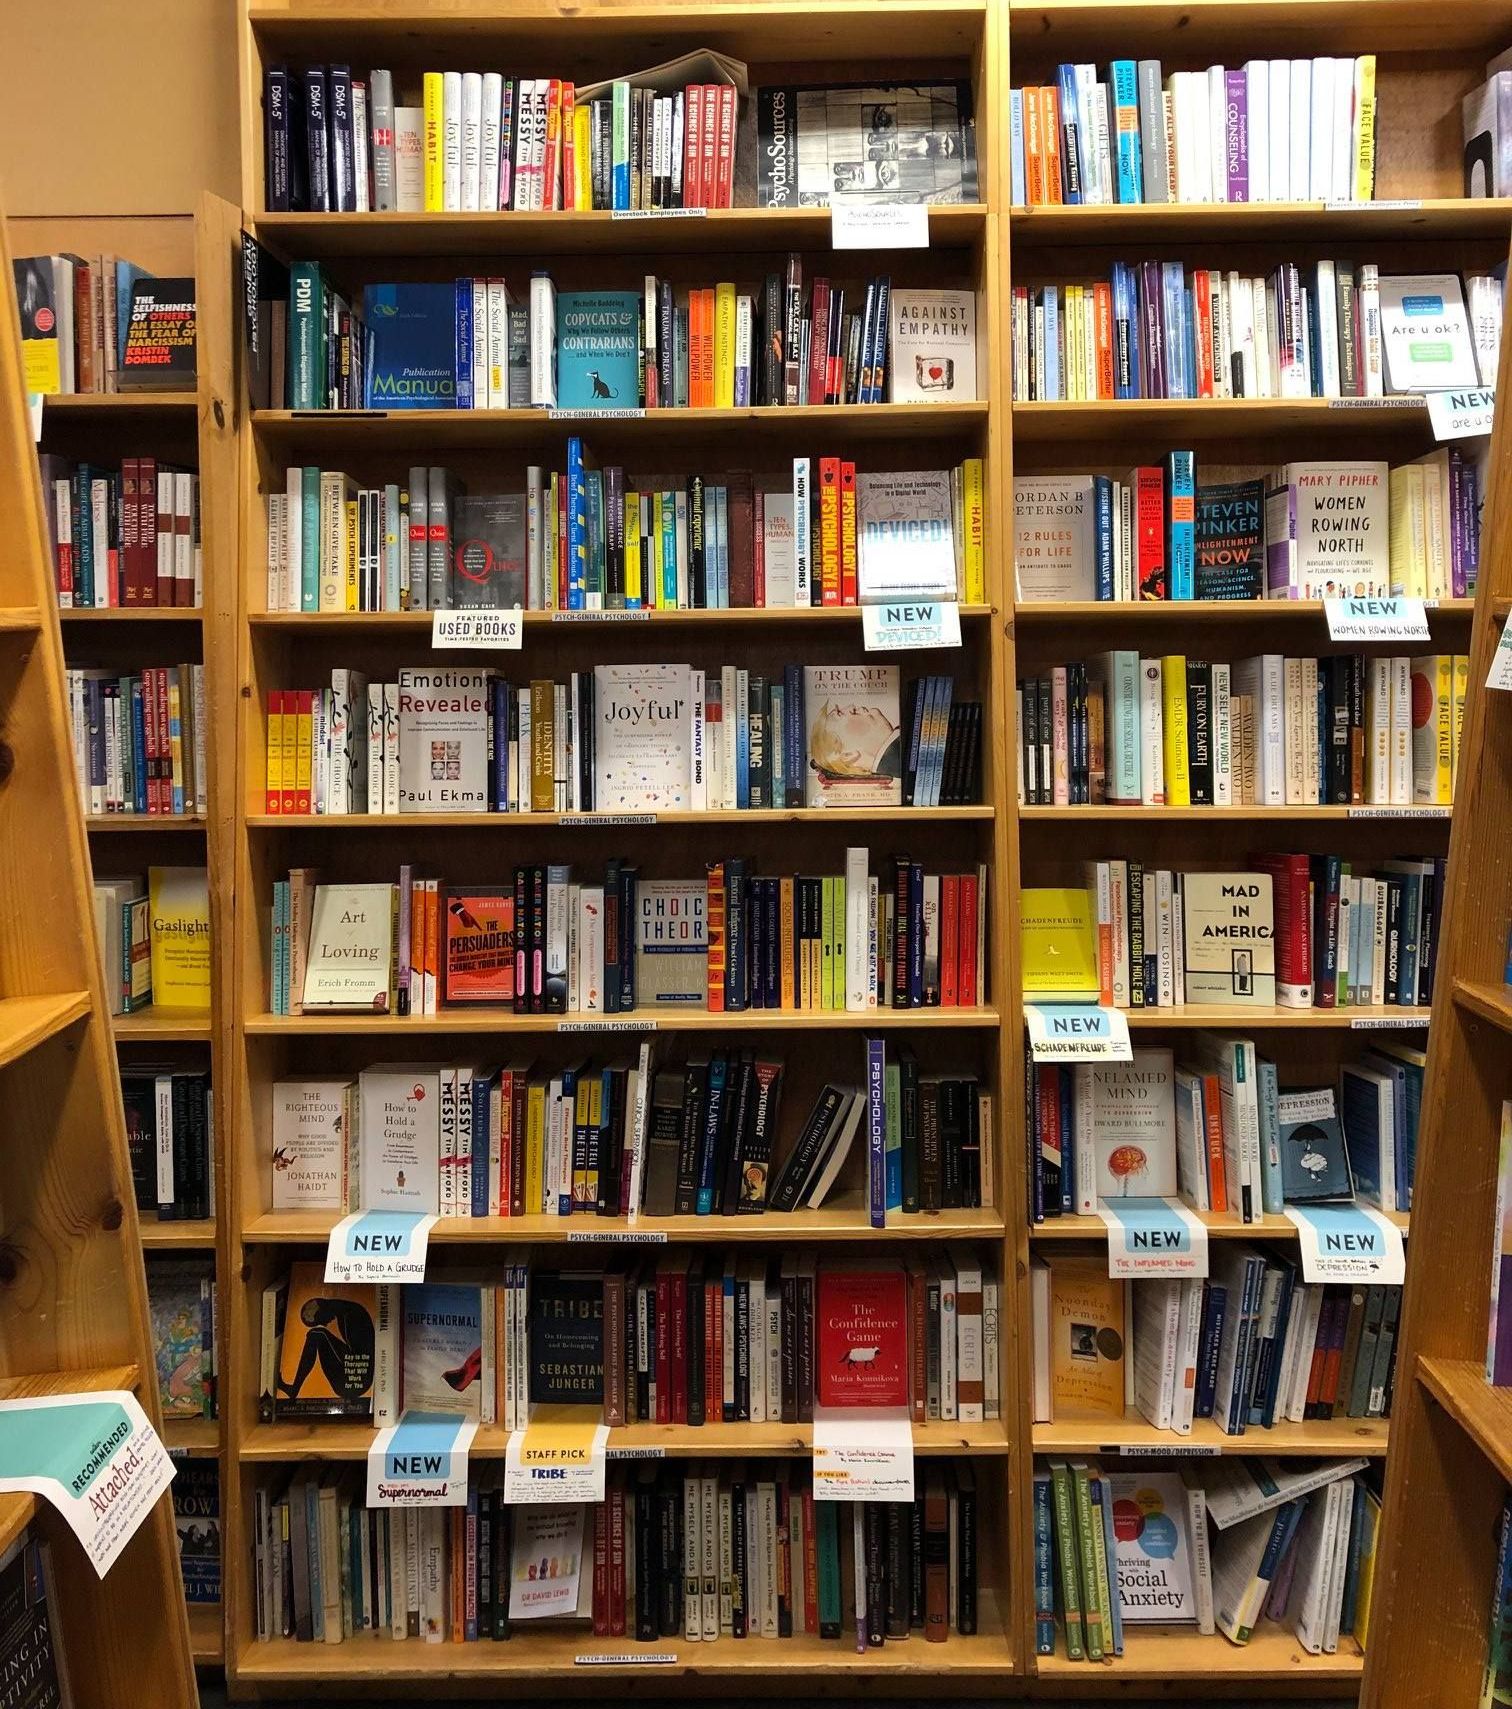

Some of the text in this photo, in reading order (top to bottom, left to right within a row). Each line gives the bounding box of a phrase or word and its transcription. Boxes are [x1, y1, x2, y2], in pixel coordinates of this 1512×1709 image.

[1117, 69, 1125, 100] PINKER
[521, 94, 531, 144] MESSY
[428, 122, 436, 162] HABIT
[1229, 103, 1238, 172] COUNSELING
[768, 91, 790, 208] PsychoSources
[135, 296, 154, 304] THE
[297, 278, 311, 312] PDM
[133, 304, 196, 312] SELFISHNESS
[901, 307, 966, 319] AGAINST
[565, 313, 632, 326] COPYCATS &
[129, 330, 148, 338] THE
[900, 323, 968, 335] EMPATHY
[1392, 325, 1415, 335] Are
[1435, 324, 1460, 334] ok?
[128, 338, 192, 346] NARCISSISM
[563, 337, 634, 350] CONTRARIANS
[126, 347, 169, 355] KRISTIN
[690, 335, 700, 380] WILLPOWER
[125, 356, 171, 364] DOMBEK
[702, 335, 712, 381] WILLPOWER
[403, 368, 450, 376] Publication
[1452, 392, 1495, 410] NEW
[1299, 474, 1378, 486] MARY PIPHER
[1315, 497, 1366, 510] WOMEN
[867, 520, 947, 543] DEVICED!
[972, 506, 981, 547] HABIT
[1312, 518, 1369, 532] ROWING
[1020, 531, 1072, 540] 12 RULES
[1017, 547, 1072, 556] FOR LIFE
[1318, 538, 1363, 553] NORTH
[1202, 549, 1250, 565] NOW
[798, 558, 806, 588] WORKS
[888, 607, 932, 622] NEW
[1351, 602, 1396, 615] NEW
[440, 623, 516, 635] USED BOOKS
[1333, 626, 1366, 635] WOMEN
[1369, 625, 1402, 634] ROWING
[815, 671, 887, 680] TRUMP
[605, 700, 679, 725] Joyful
[1439, 702, 1450, 761] FACE VALUE
[751, 713, 762, 768] HEALING
[1221, 731, 1229, 773] WORLD
[1222, 885, 1260, 897] MAD
[340, 911, 366, 923] Art
[1233, 905, 1249, 917] IN
[486, 921, 498, 932] THE
[321, 944, 379, 961] Loving
[318, 979, 376, 987] Erich Fromm
[1054, 1018, 1100, 1033] NEW
[1034, 1044, 1107, 1052] SCHADENFREUDE
[1107, 1089, 1148, 1099] MIND
[286, 1104, 338, 1112] RIGHTEOUS
[384, 1103, 416, 1113] How to
[442, 1083, 453, 1135] MESSY
[460, 1083, 471, 1136] MESSY
[707, 1090, 720, 1134] IN-LAWS
[872, 1062, 881, 1154] PSYCHOLOGY
[299, 1115, 324, 1123] MIND
[385, 1116, 415, 1126] Hold a
[384, 1129, 417, 1140] Grudge
[1209, 1115, 1218, 1159] UNSTUCK
[287, 1172, 337, 1180] JONATHAN
[298, 1183, 327, 1191] HAIDT
[354, 1235, 402, 1251] NEW
[571, 1234, 620, 1242] PSYCH-GENERAL
[1133, 1231, 1181, 1247] NEW
[1326, 1235, 1375, 1250] NEW
[354, 1264, 362, 1272] TO
[367, 1262, 384, 1271] HOLD
[387, 1263, 392, 1271] A
[395, 1262, 424, 1272] GRUDGE
[1317, 1263, 1368, 1272] DEPRESSION
[380, 1286, 389, 1332] SUPERNORMAL
[539, 1300, 603, 1318] TRIBE
[852, 1304, 875, 1314] The
[408, 1312, 478, 1328] SUPERNORMAL
[829, 1317, 898, 1329] Confidence
[846, 1331, 881, 1343] Game
[539, 1364, 603, 1375] SEBASTIAN
[549, 1379, 595, 1389] JUNGER
[831, 1374, 899, 1382] Maria Konnikova
[72, 1421, 128, 1492] RECOMMENDED
[527, 1450, 585, 1459] STAFF PICK
[1127, 1446, 1214, 1455] PSYCH-MOOD/DEPRESSION
[394, 1457, 441, 1474] NEW
[531, 1469, 567, 1479] TRIBE
[89, 1446, 144, 1522] Attached.
[378, 1483, 447, 1502] Supernormal
[428, 1547, 440, 1593] Empathy
[1117, 1571, 1168, 1588] Social
[1119, 1593, 1184, 1608] Anxiety
